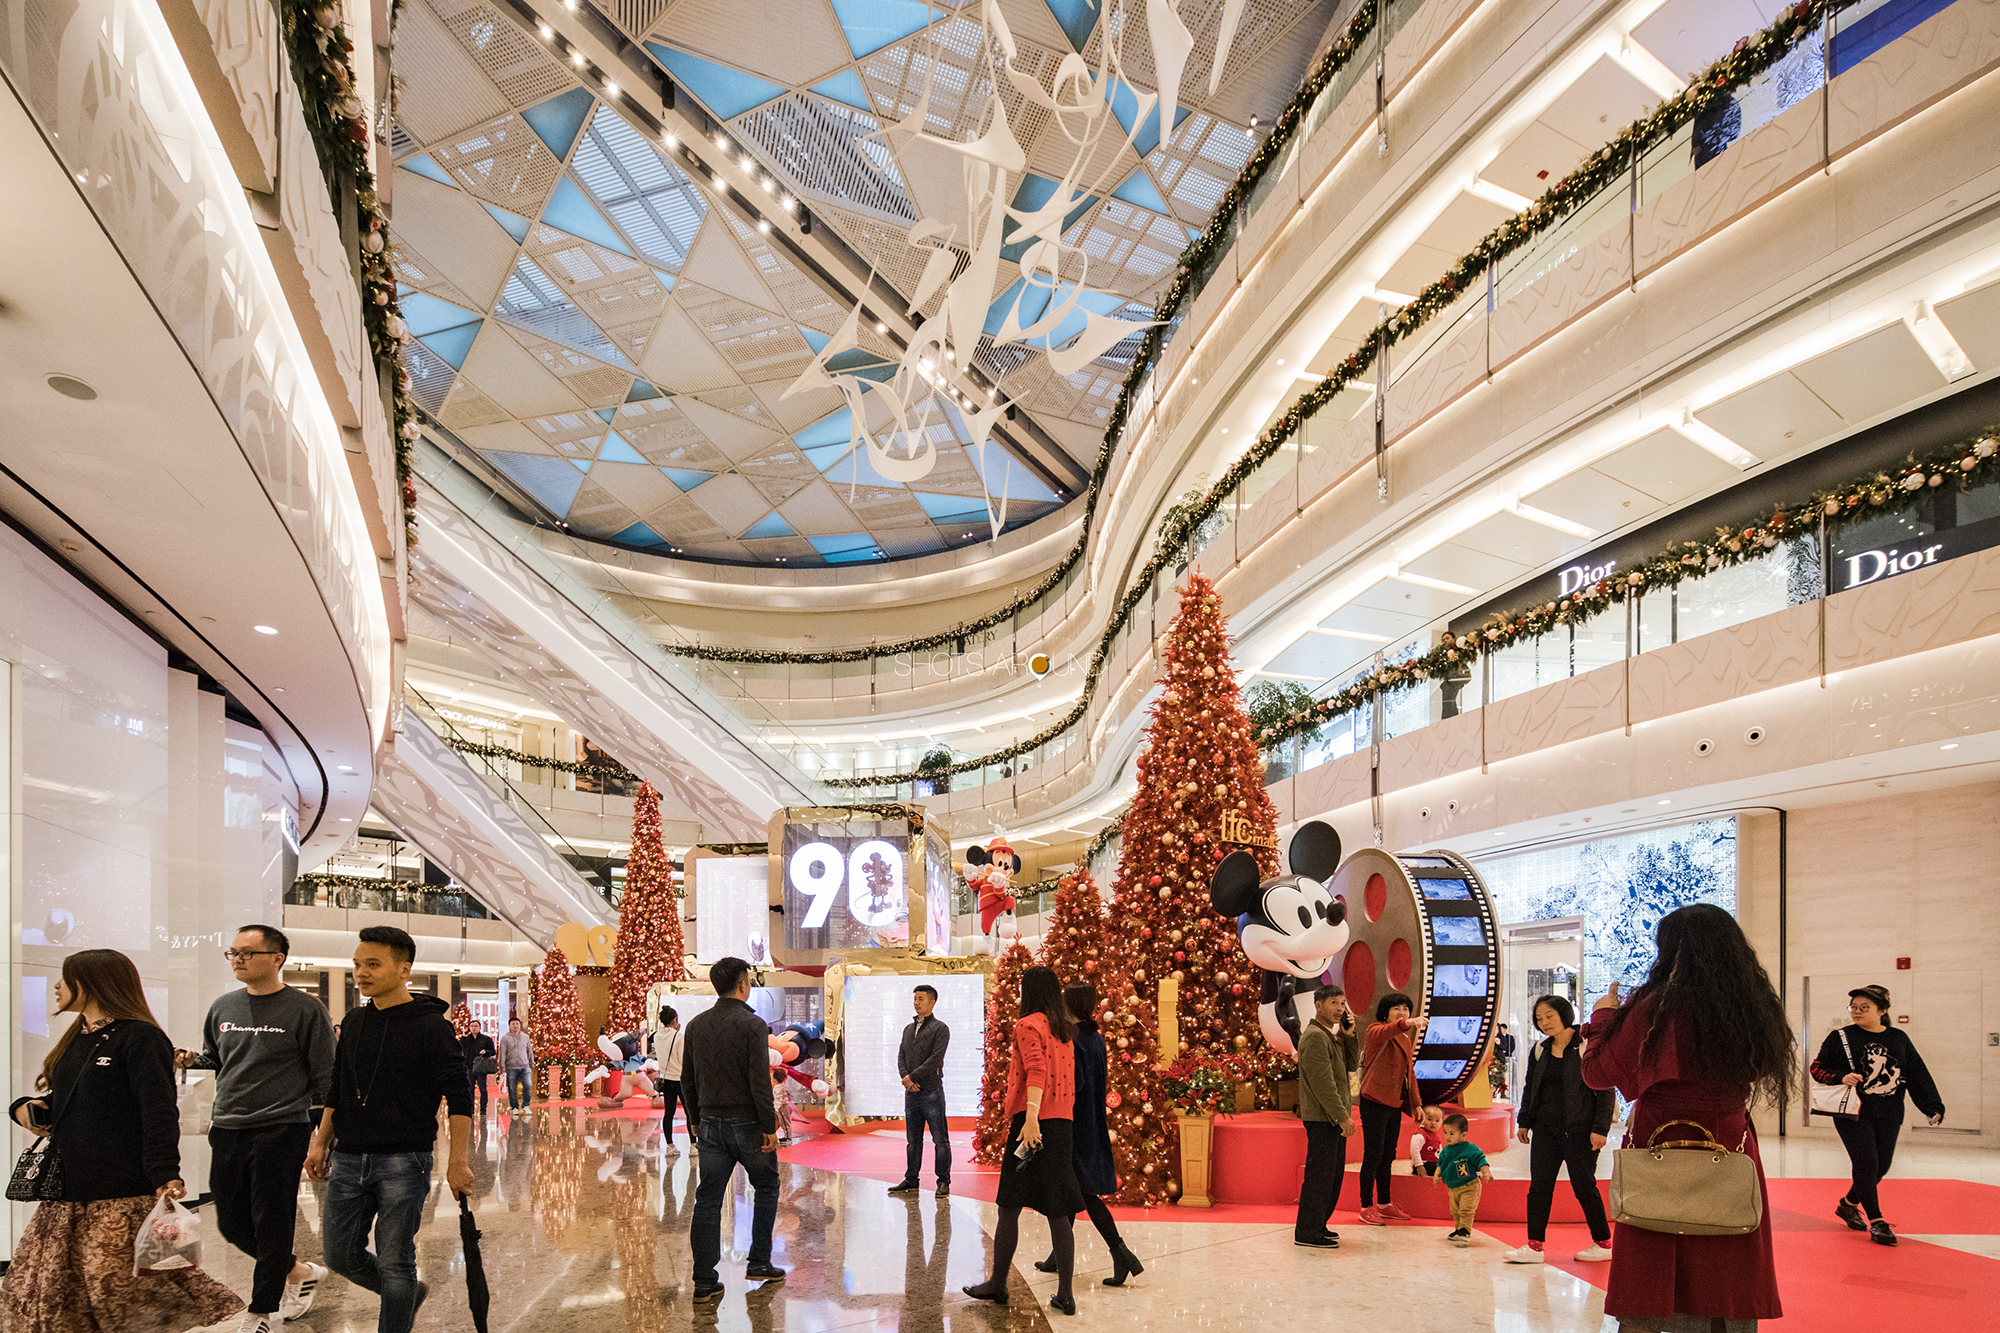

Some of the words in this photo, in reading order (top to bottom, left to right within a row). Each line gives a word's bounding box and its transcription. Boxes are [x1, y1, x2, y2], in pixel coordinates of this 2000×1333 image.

[1557, 560, 1616, 598] Dior
[1842, 544, 1943, 589] Dior
[789, 840, 904, 929] 90
[219, 1021, 286, 1036] Champion
